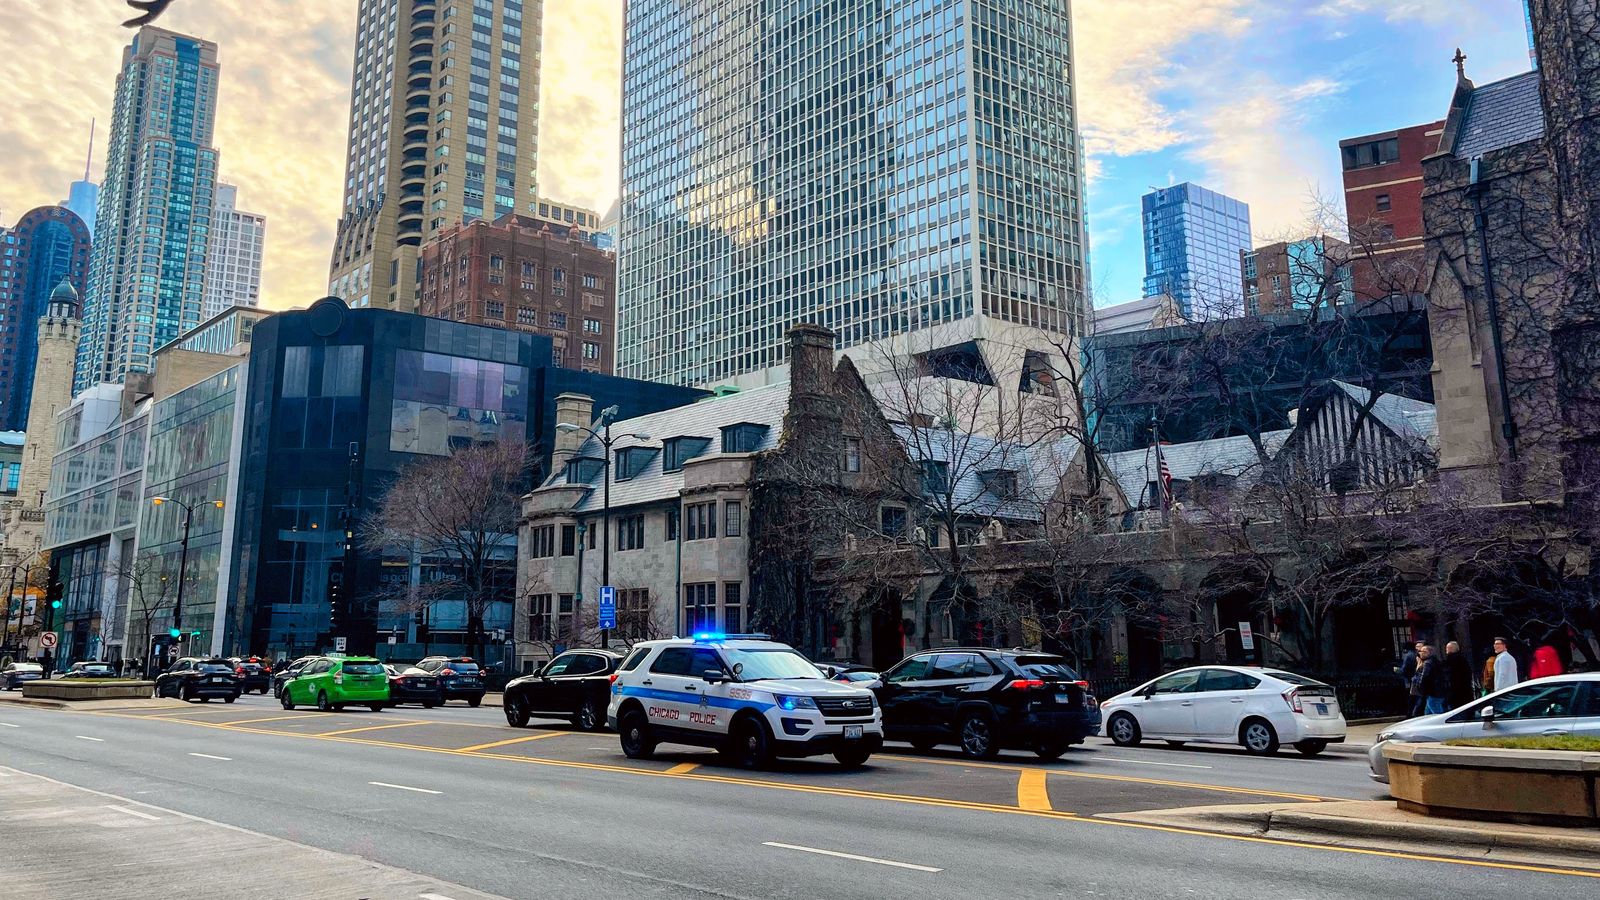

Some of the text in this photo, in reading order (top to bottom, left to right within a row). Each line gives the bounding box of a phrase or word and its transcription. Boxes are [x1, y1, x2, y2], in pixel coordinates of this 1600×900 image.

[601, 587, 613, 604] H
[648, 706, 717, 725] CHICAGO POLICE
